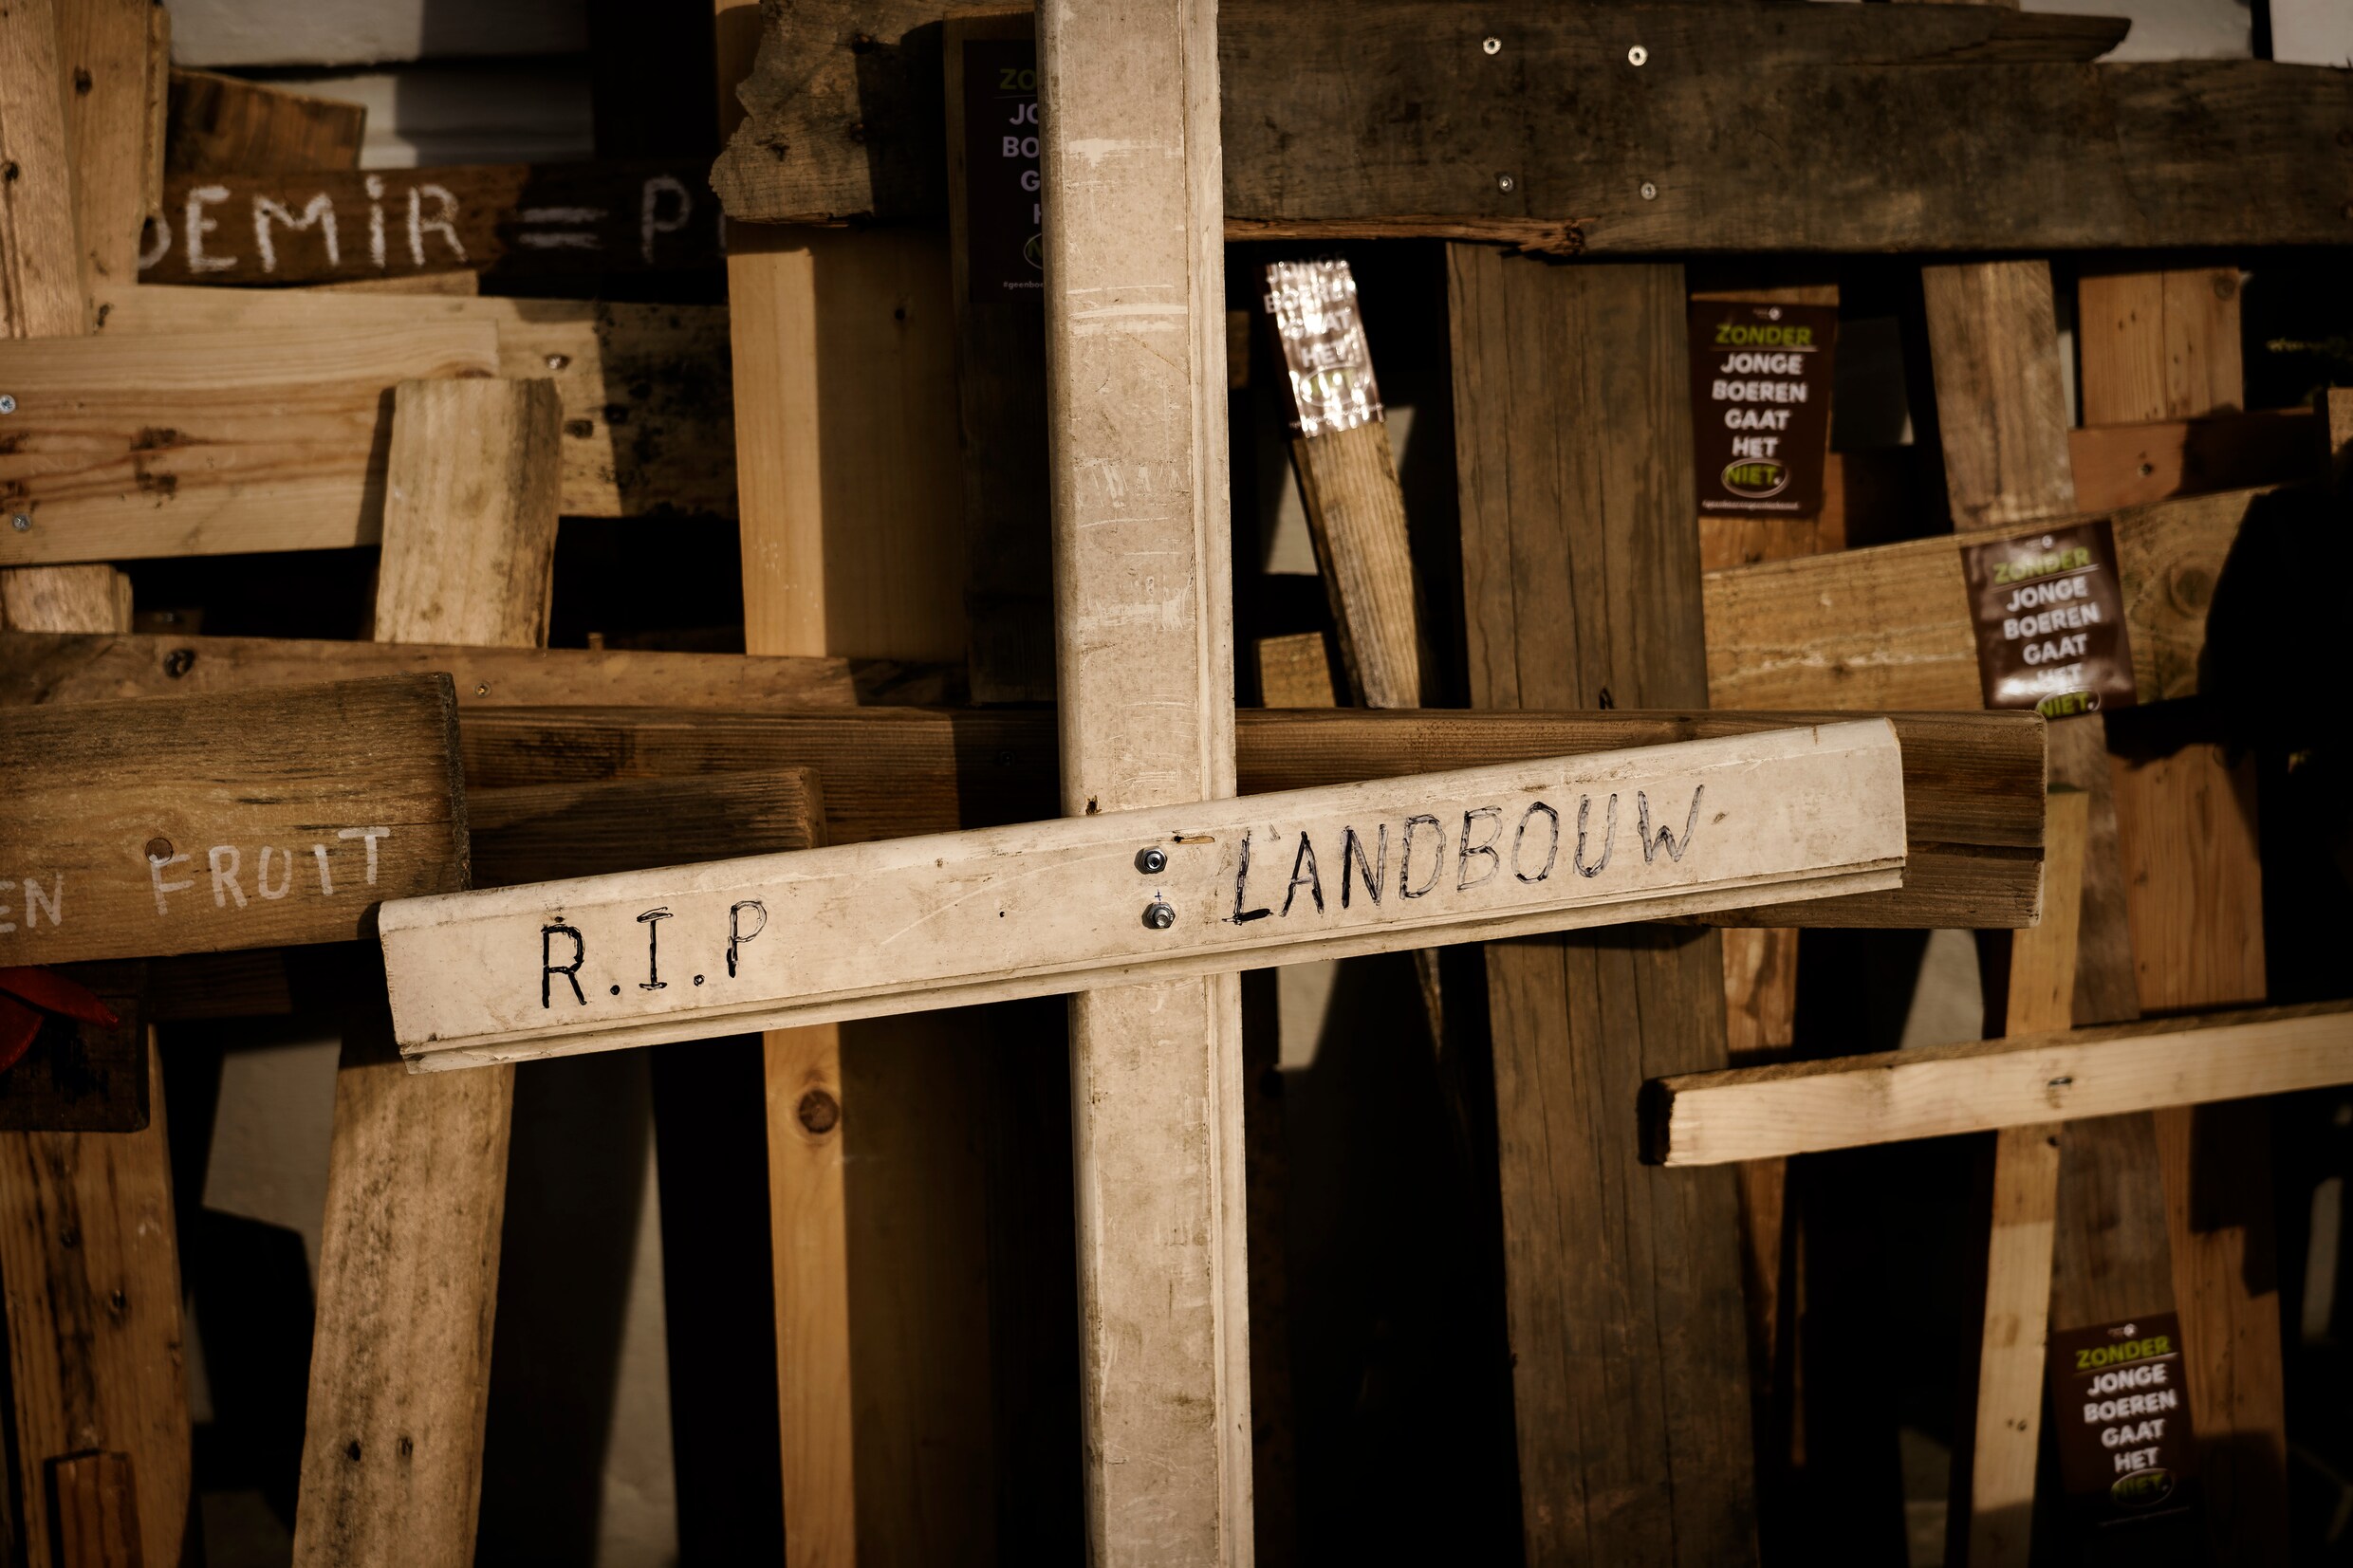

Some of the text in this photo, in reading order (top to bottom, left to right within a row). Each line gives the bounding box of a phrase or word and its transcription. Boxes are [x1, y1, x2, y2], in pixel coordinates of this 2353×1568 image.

[1714, 323, 1814, 345] ZONDER
[1719, 352, 1805, 376] JONGE
[1711, 378, 1809, 403] BOEREN
[1724, 407, 1793, 431] GAAT
[1732, 435, 1781, 457] HET
[1993, 546, 2091, 585] ZONDER
[2006, 576, 2088, 612] JONGE
[2003, 602, 2102, 640] BOEREN
[2023, 633, 2088, 665] GAAT
[150, 827, 390, 915] FRUIT
[1222, 784, 1705, 926] LANDBOUW
[2075, 1335, 2172, 1371] ZONDER
[2086, 1363, 2169, 1398] JONGE
[2083, 1389, 2179, 1424] BOEREN
[2101, 1418, 2167, 1449] GAAT
[2113, 1447, 2161, 1474] HET
